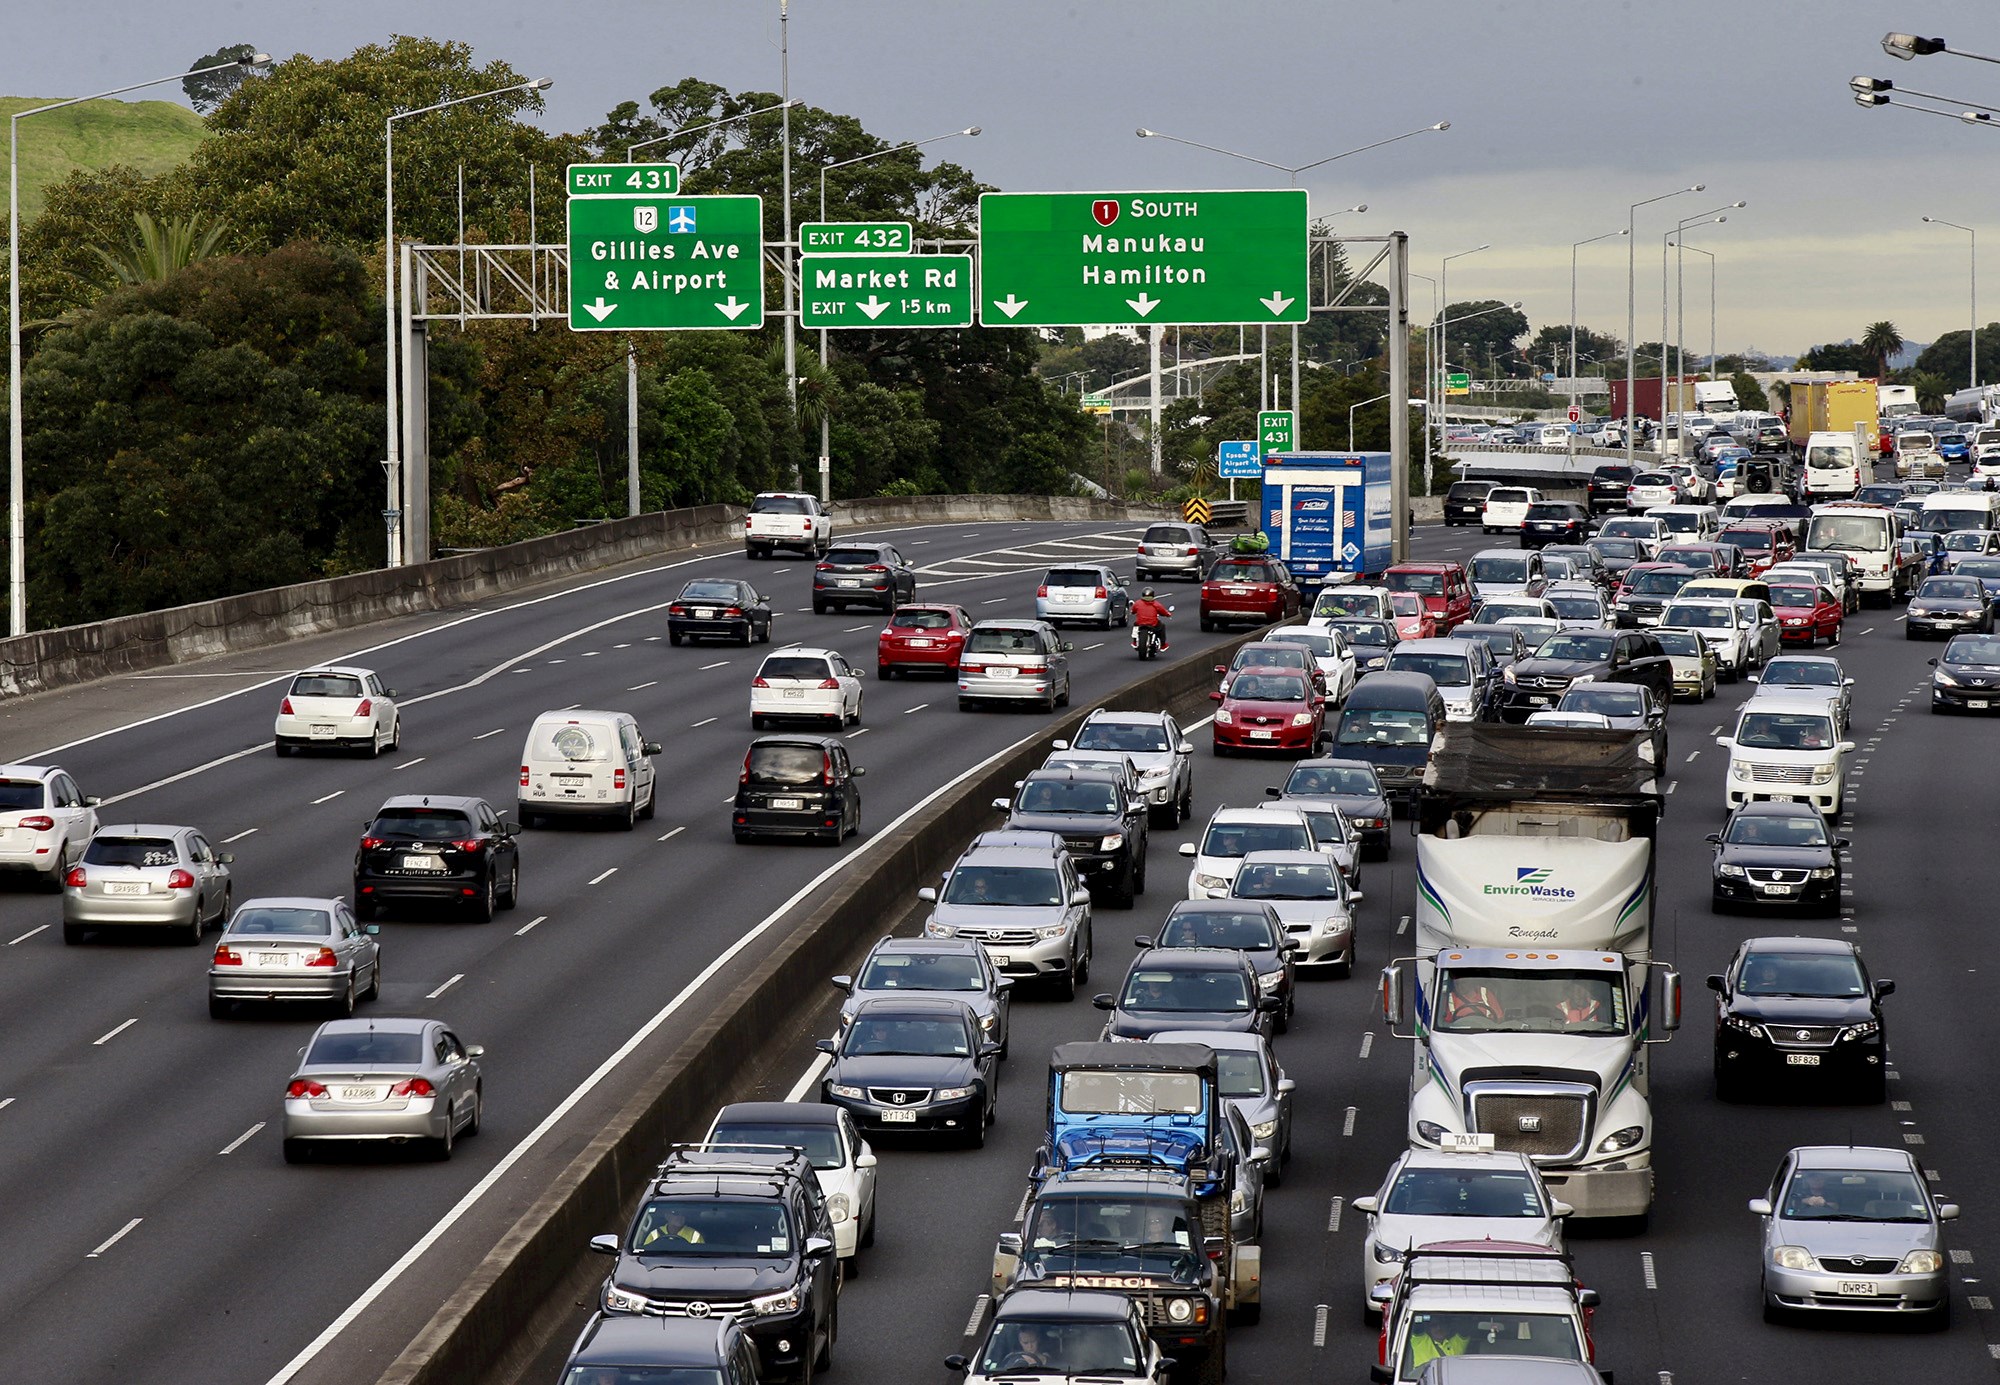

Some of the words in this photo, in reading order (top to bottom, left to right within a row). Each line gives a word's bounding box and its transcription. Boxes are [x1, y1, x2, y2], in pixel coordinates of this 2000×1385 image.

[577, 173, 612, 187] EXIT
[626, 171, 670, 189] 431
[1130, 199, 1197, 217] SOUTH
[638, 211, 653, 226] 12
[809, 232, 845, 245] EXIT
[854, 230, 902, 247] 432
[1082, 234, 1204, 253] Manukau
[591, 240, 675, 260] Gillies
[690, 240, 739, 259] Ave
[604, 270, 619, 290] &
[631, 270, 727, 295] Airport
[816, 269, 909, 289] Market
[925, 269, 956, 288] Rd
[1083, 265, 1206, 285] Hamilton
[812, 302, 846, 315] EXIT
[926, 300, 951, 314] km
[1264, 417, 1288, 427] EXIT
[1264, 432, 1289, 443] 431
[1484, 884, 1576, 899] EnviroWaste
[1508, 925, 1559, 939] Renegade
[1787, 1055, 1819, 1065] KBF826
[882, 1110, 916, 1121] BYT343
[1454, 1135, 1479, 1145] TAXI
[1055, 1275, 1159, 1289] PATROL
[1842, 1283, 1873, 1295] DWR54
